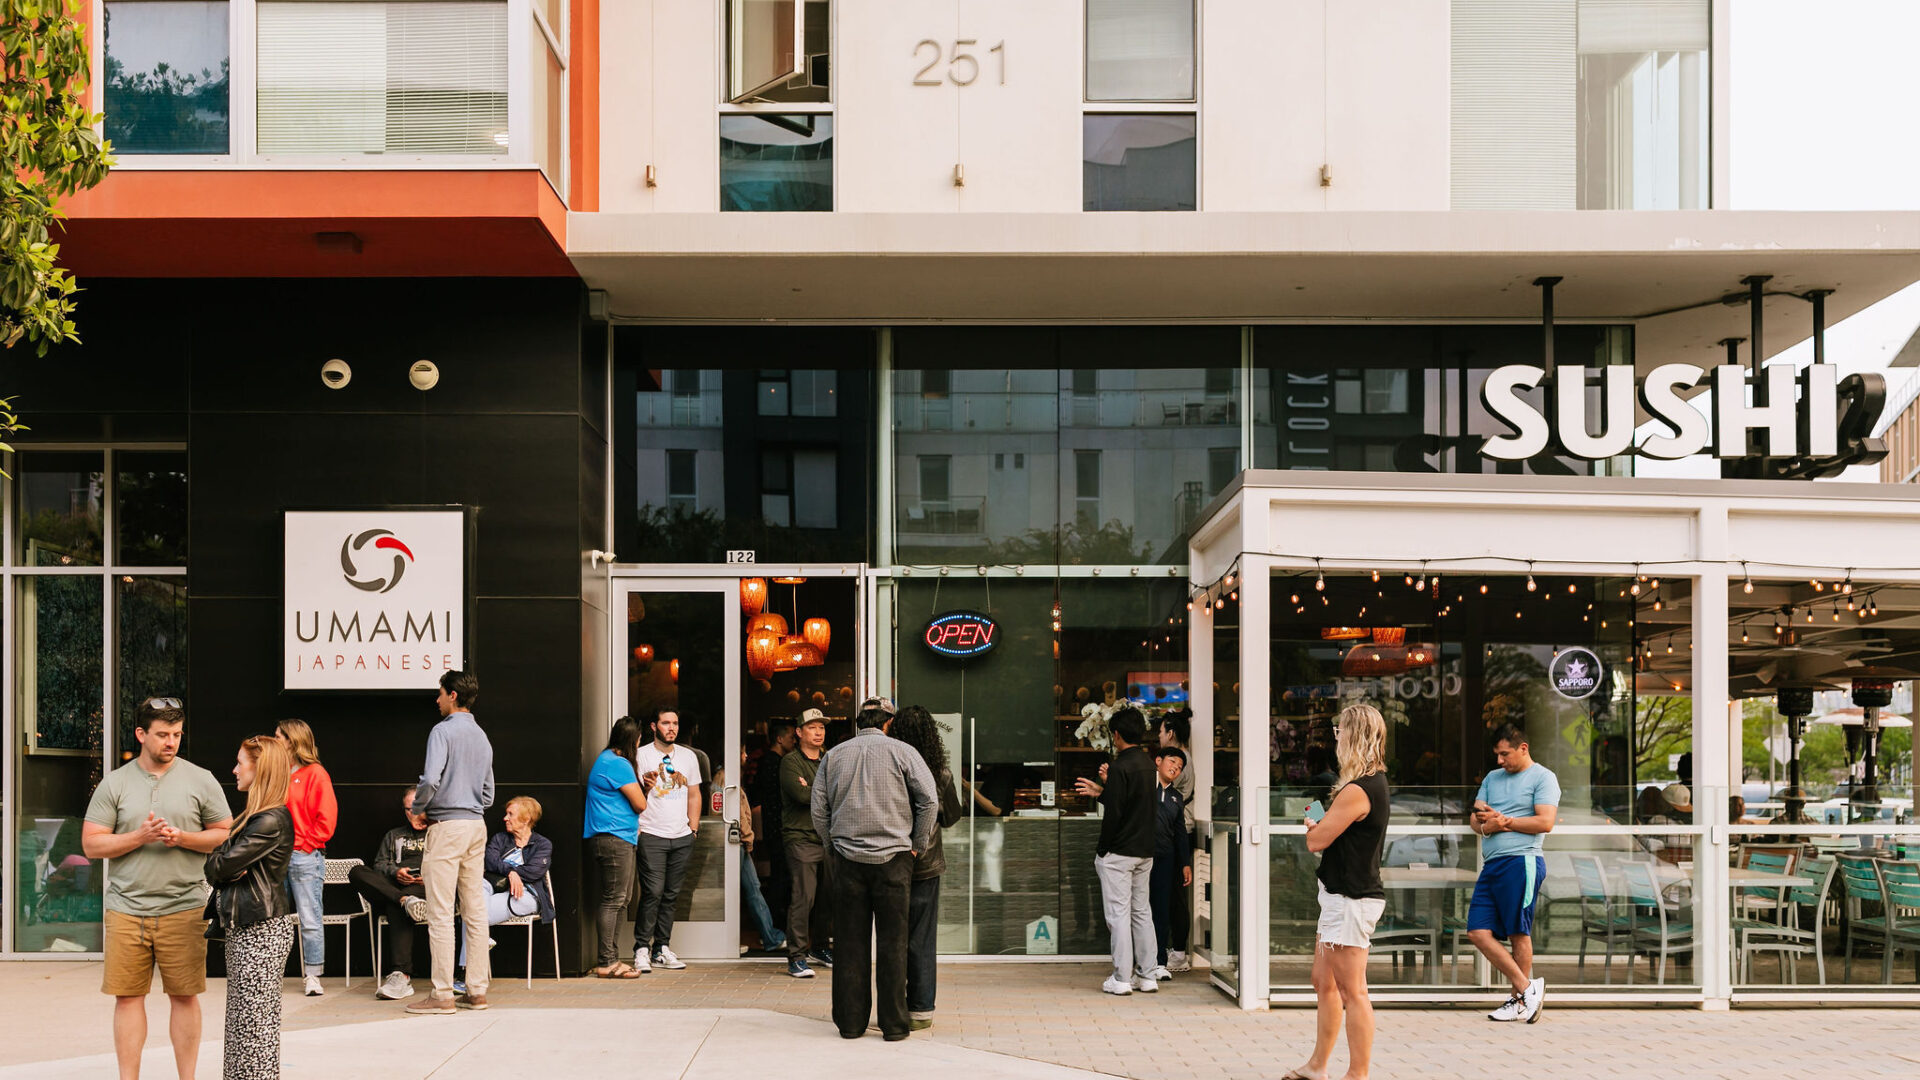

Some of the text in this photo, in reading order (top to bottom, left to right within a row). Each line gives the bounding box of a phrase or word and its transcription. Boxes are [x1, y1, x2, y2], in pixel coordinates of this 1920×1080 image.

[912, 39, 1005, 87] 251
[1478, 362, 1840, 462] SUSHI
[729, 551, 753, 563] 122
[296, 610, 451, 643] UMAMI
[926, 623, 995, 646] OPEN
[297, 654, 452, 672] JAPANESE
[1558, 677, 1594, 687] SAPPORO
[1033, 921, 1051, 940] A
